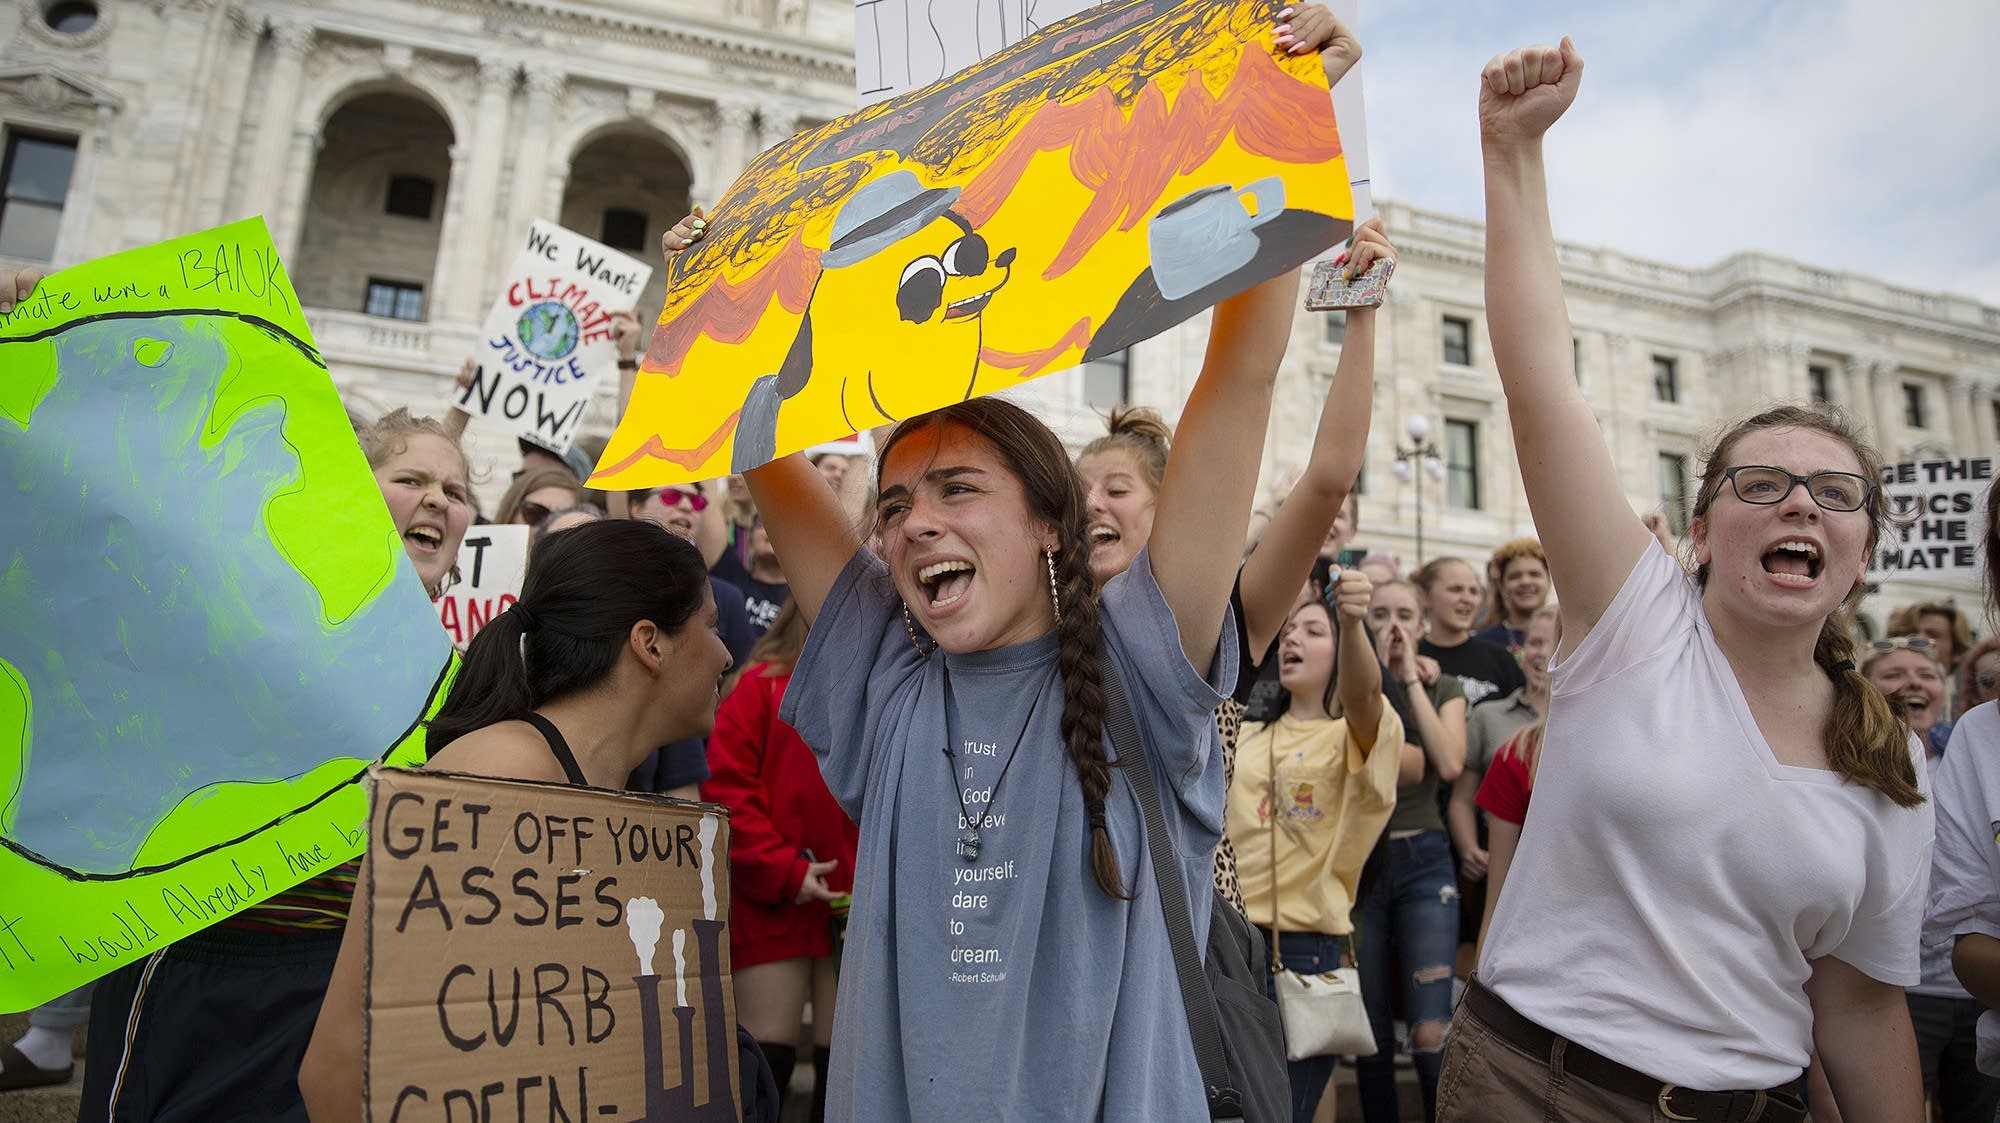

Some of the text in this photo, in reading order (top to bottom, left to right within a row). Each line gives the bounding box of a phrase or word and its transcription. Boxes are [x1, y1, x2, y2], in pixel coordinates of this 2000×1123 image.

[159, 285, 170, 299] a
[178, 243, 291, 316] BANK
[527, 226, 639, 295] We Want
[507, 277, 615, 346] CLIMATE
[489, 335, 585, 385] JUSTICE
[460, 364, 588, 441] NOW!
[1922, 459, 1992, 483] THE
[964, 740, 997, 756] trust
[964, 764, 973, 779] in
[383, 792, 698, 869] GET OFF YOUR
[161, 859, 268, 925] Already
[276, 840, 332, 877] have
[396, 864, 623, 933] ASSES
[952, 891, 988, 909] dare
[954, 861, 1018, 885] yourself.
[950, 918, 964, 935] to
[951, 945, 1002, 963] dream.
[437, 963, 615, 1051] CURB
